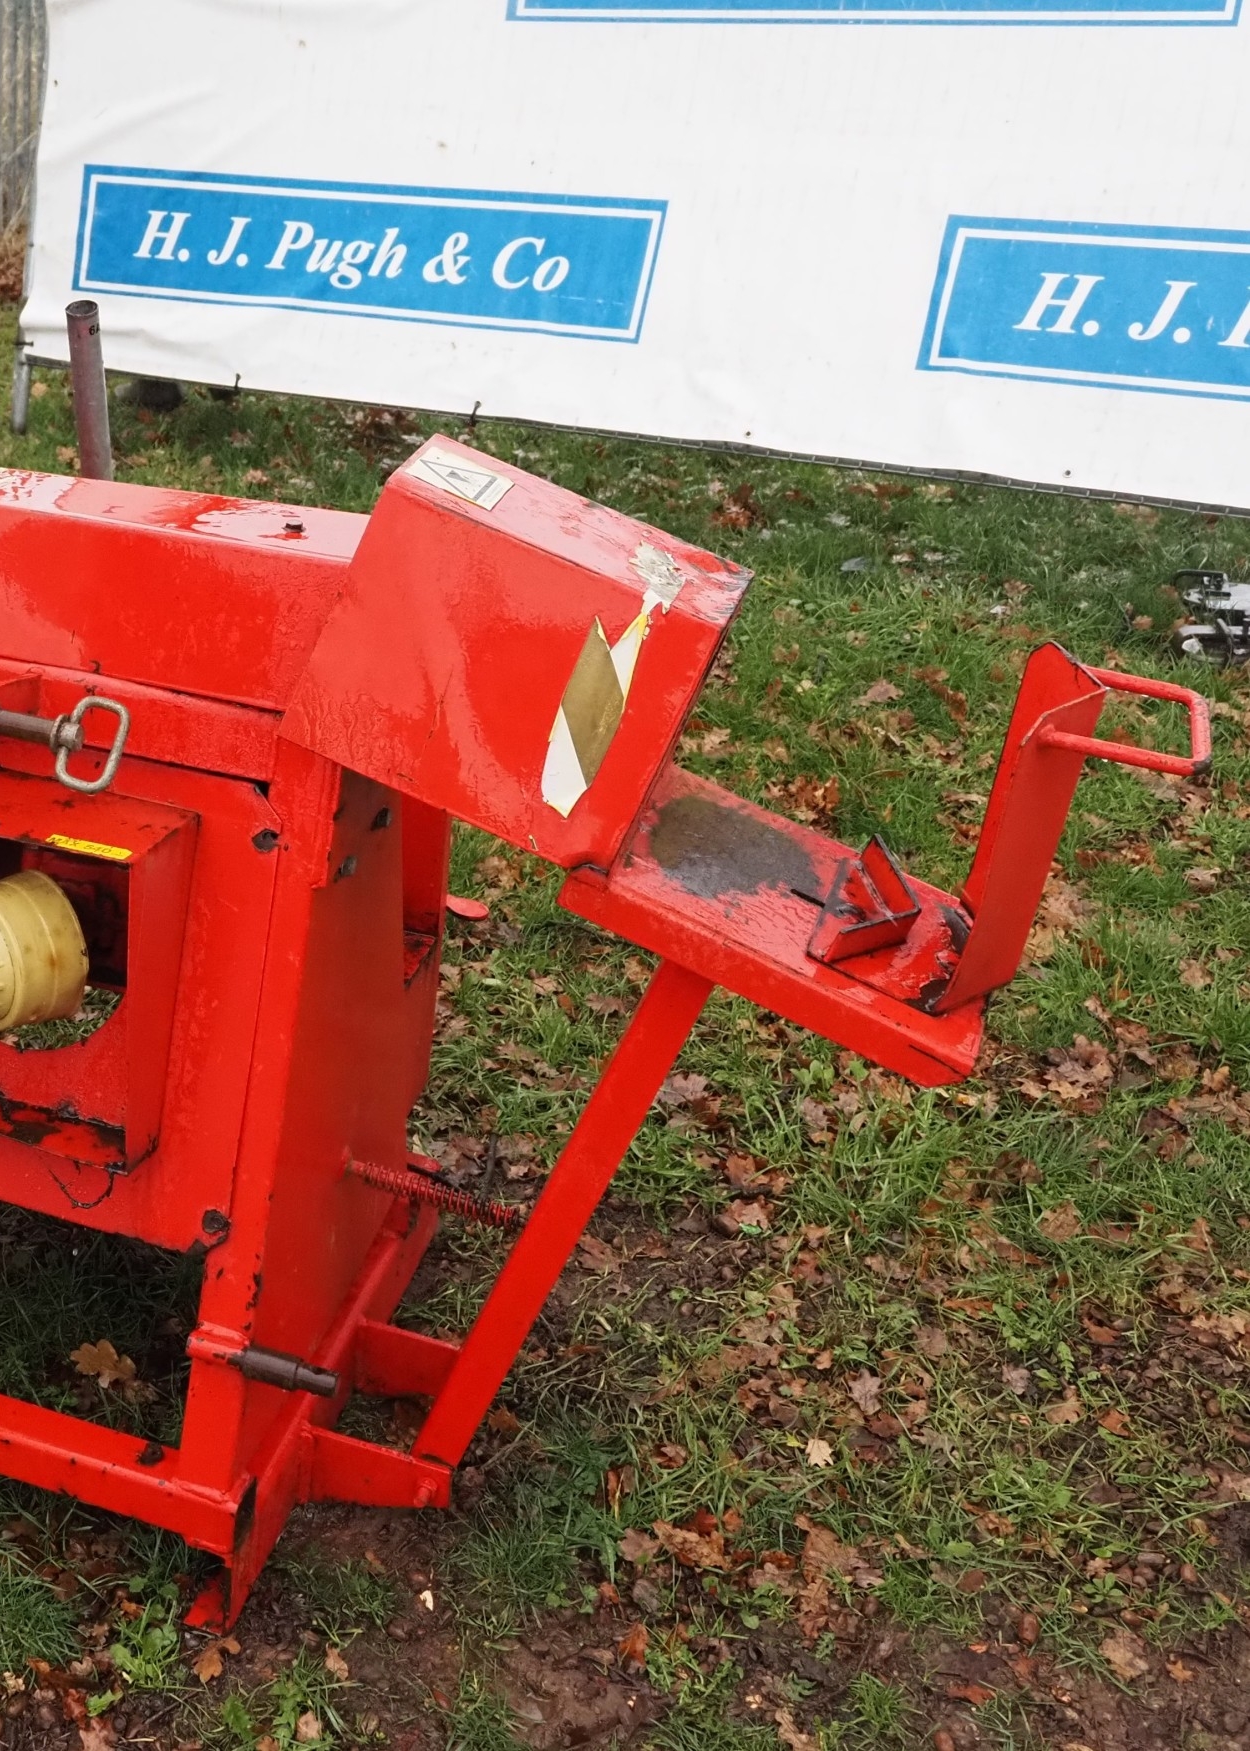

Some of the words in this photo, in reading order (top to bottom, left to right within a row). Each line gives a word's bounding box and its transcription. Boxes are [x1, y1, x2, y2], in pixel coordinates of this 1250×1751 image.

[133, 210, 191, 262] H.
[207, 216, 252, 267] J.
[264, 220, 407, 289] Pugh
[422, 231, 471, 285] &
[492, 236, 570, 291] Co
[1012, 272, 1105, 336] H.
[1127, 280, 1198, 343] J.
